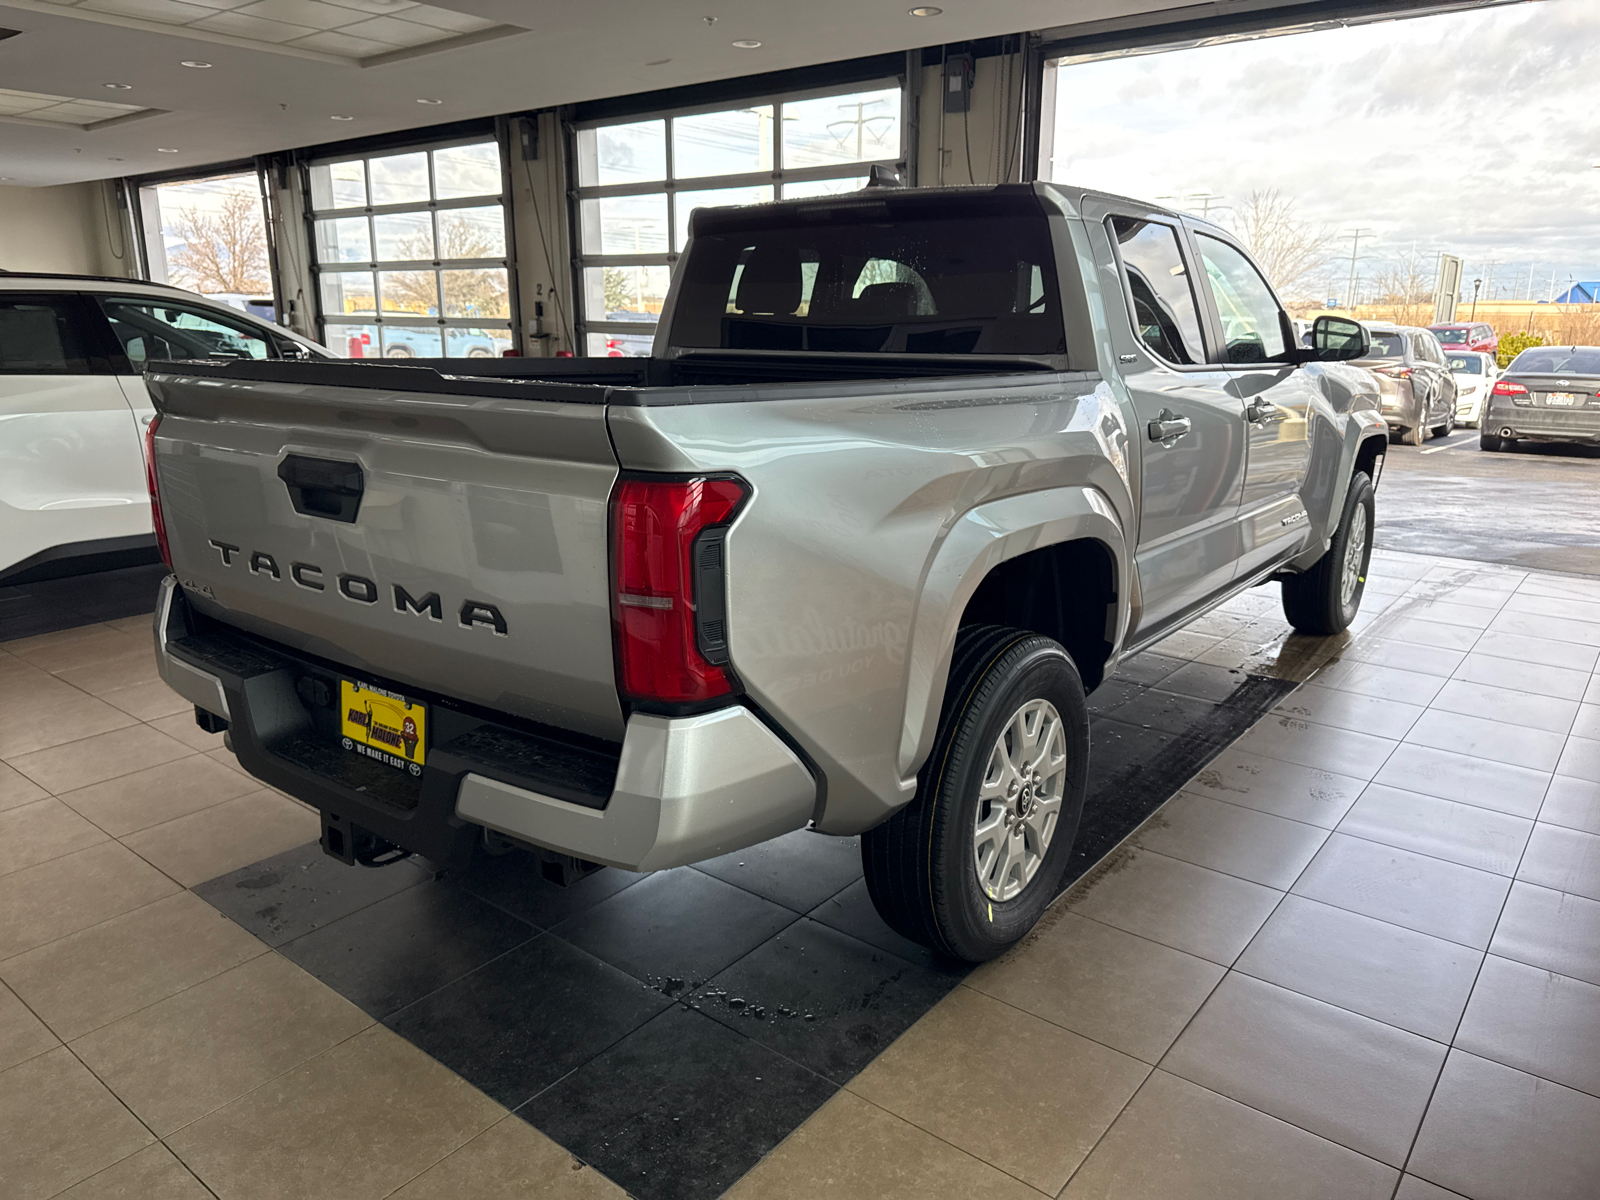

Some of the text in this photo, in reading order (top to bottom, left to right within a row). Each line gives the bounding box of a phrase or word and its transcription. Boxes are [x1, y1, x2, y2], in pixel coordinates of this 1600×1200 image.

[536, 283, 543, 296] 2
[1280, 509, 1308, 527] TACOMA
[208, 538, 510, 638] TACOMA
[357, 680, 405, 702] KARL MALONE TOYOTA
[347, 708, 370, 728] KARL
[405, 722, 415, 735] 32
[370, 725, 403, 749] MALONE
[356, 743, 405, 770] WE MAKE IT EASY
